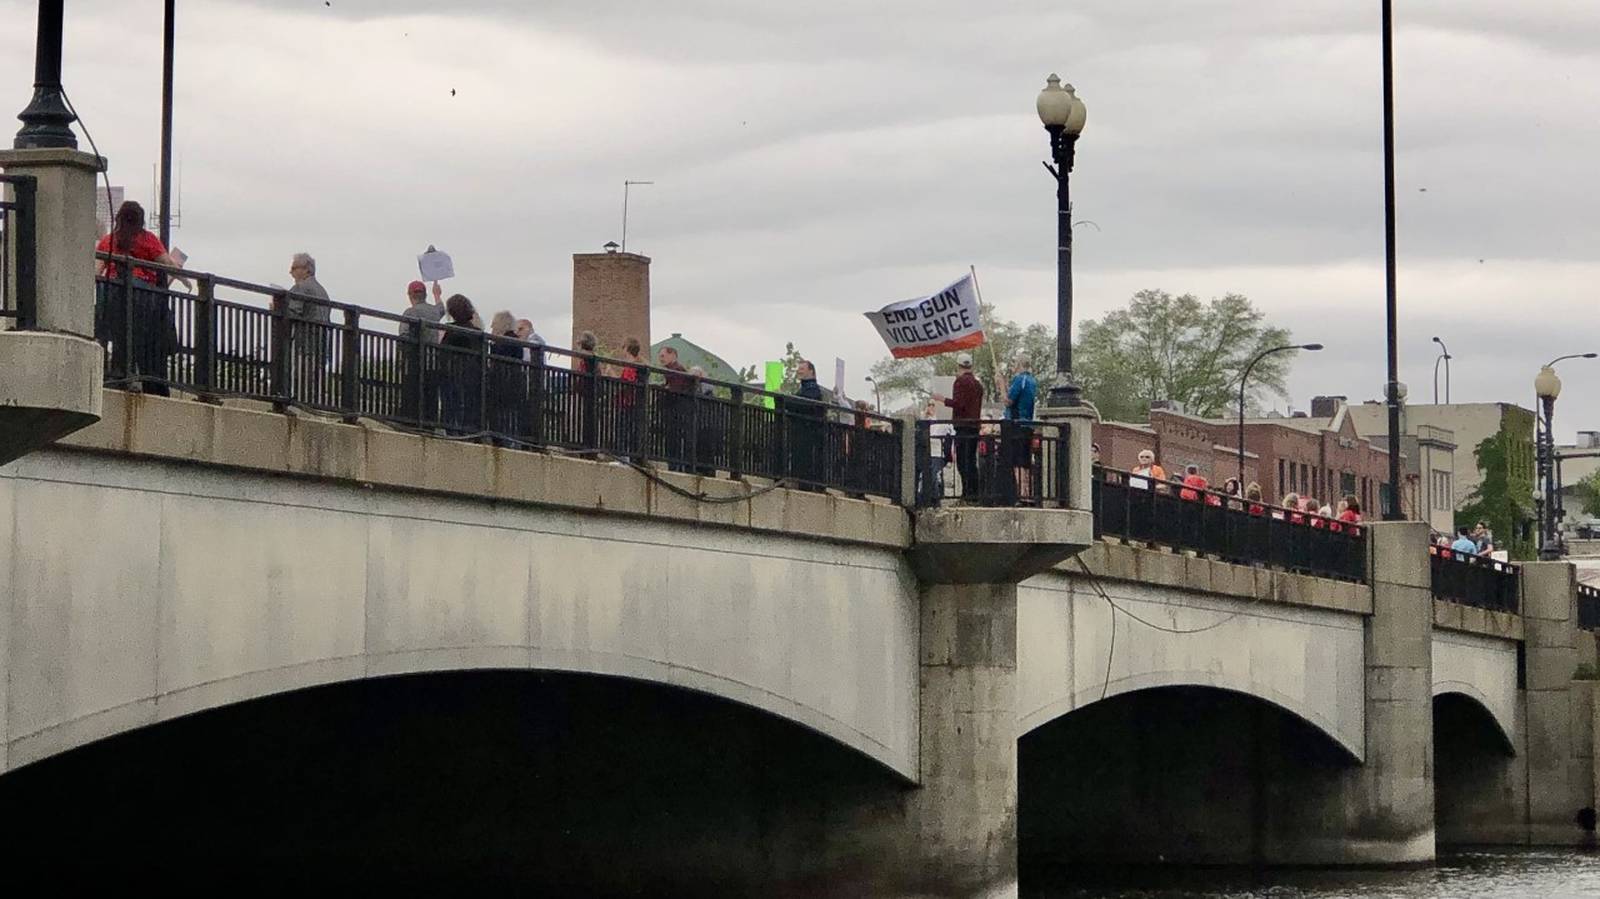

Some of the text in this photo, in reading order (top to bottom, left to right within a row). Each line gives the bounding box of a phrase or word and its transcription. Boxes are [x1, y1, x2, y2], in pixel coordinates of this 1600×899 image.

[883, 288, 961, 324] END GUN
[886, 309, 973, 343] VIOLENCE
